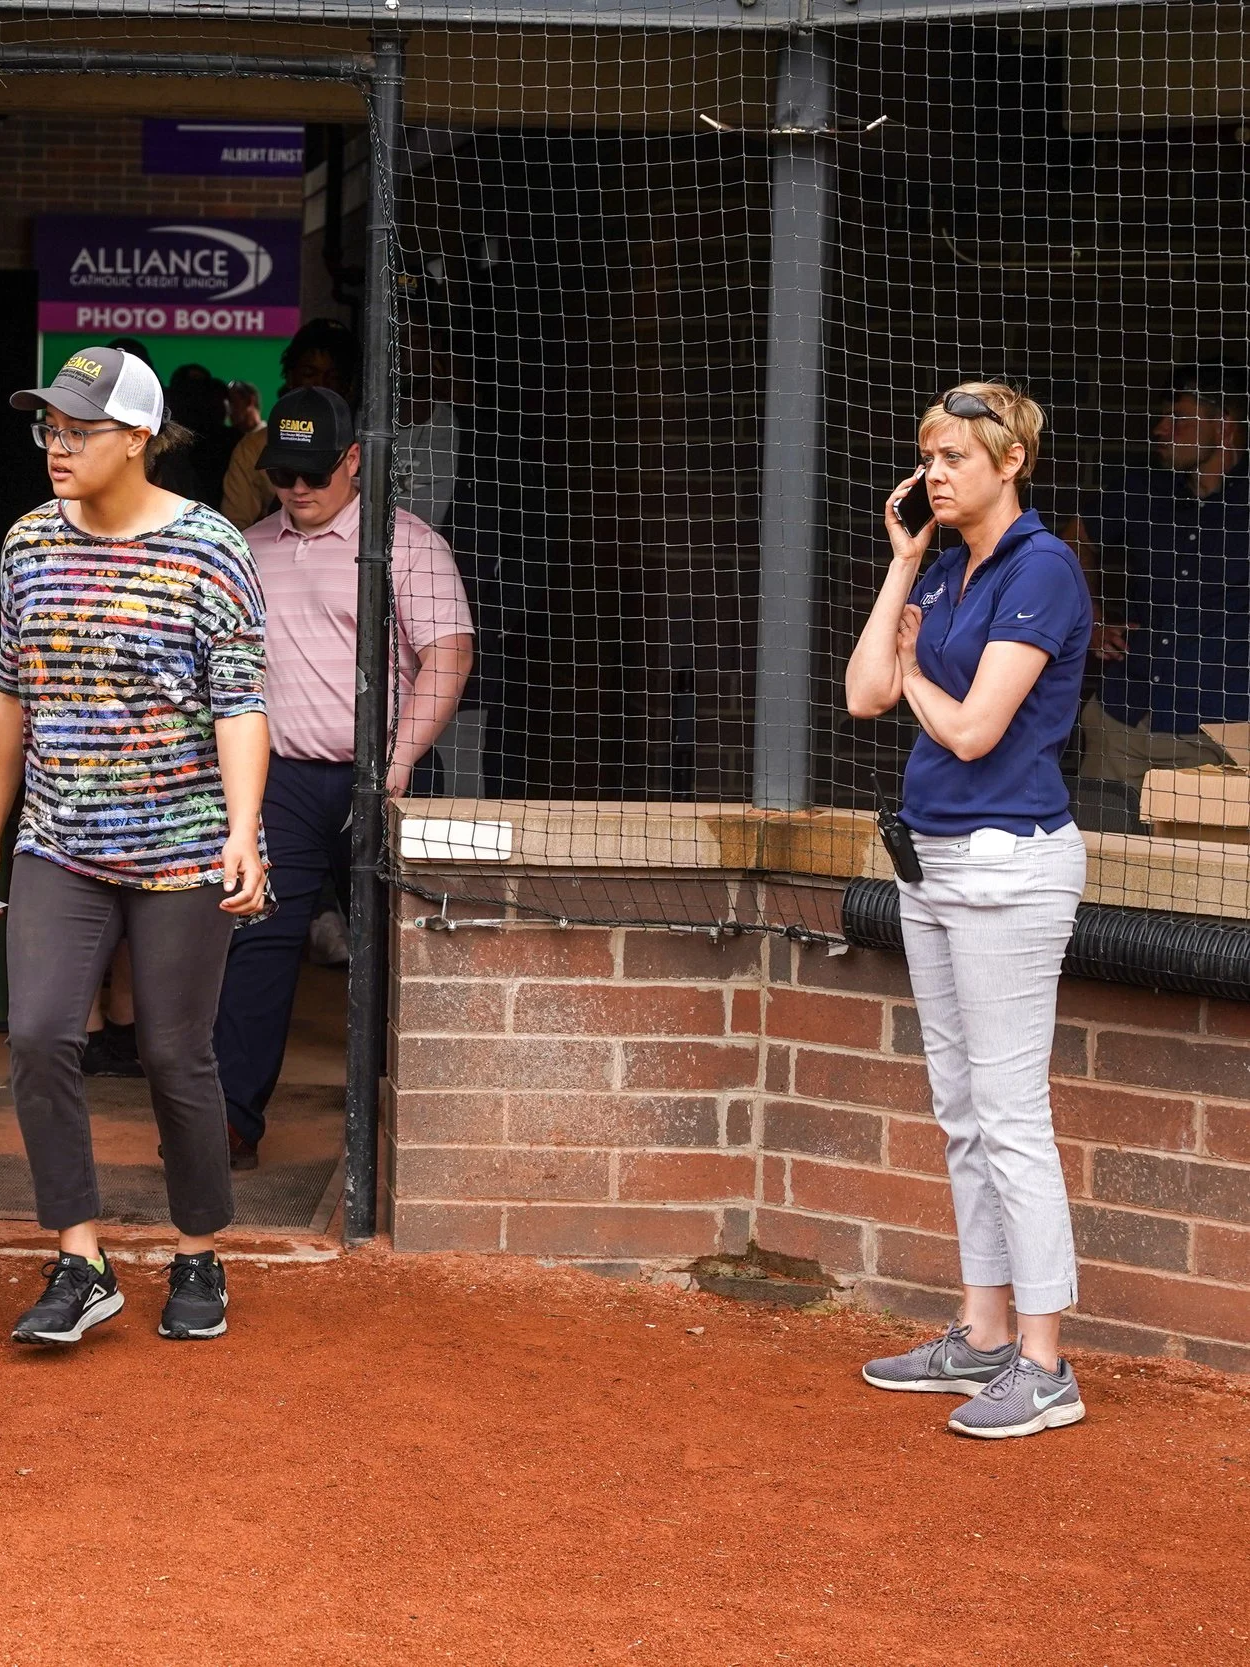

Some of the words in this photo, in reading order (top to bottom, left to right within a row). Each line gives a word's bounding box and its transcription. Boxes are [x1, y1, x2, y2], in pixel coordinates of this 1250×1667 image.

[220, 147, 267, 162] ALBERT
[70, 248, 229, 276] ALLIANCE
[69, 274, 132, 287] CATHOLIC
[136, 275, 179, 288] CREDIT
[183, 277, 229, 289] UNION
[76, 306, 167, 329] PHOTO
[174, 308, 265, 331] BOOTH
[279, 418, 314, 432] SEMCA
